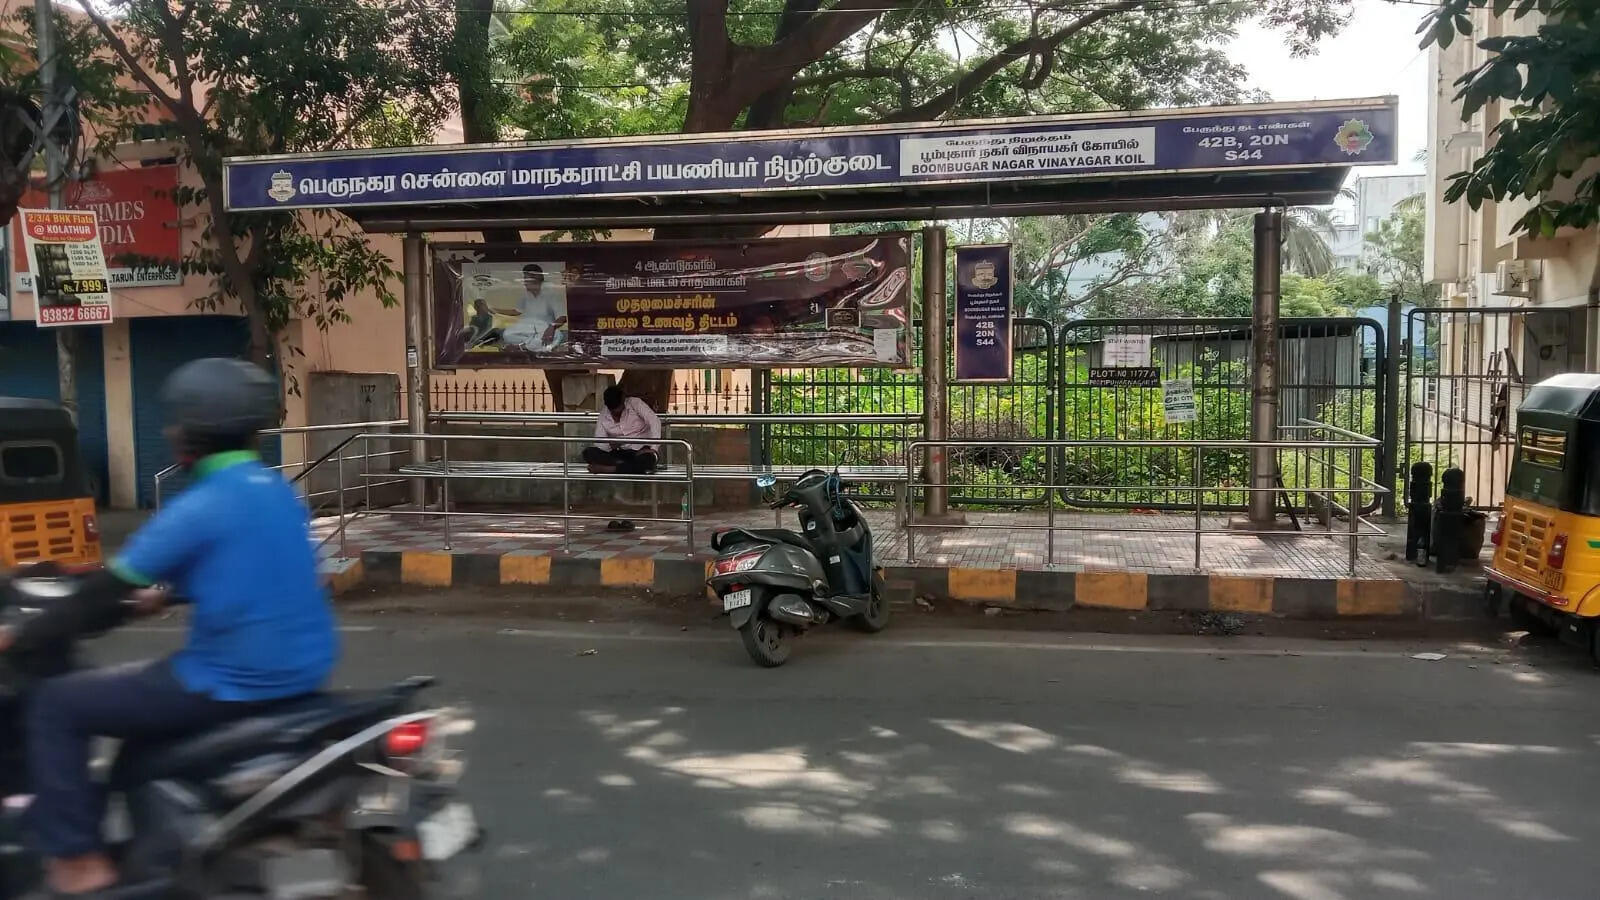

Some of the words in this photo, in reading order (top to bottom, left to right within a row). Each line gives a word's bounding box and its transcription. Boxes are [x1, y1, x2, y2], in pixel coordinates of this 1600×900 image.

[1198, 136, 1242, 148] 42B,
[1250, 134, 1289, 146] 20N
[980, 145, 1009, 160] நகர்
[1012, 142, 1078, 158] விநாயகர்
[1082, 138, 1139, 152] கோயில்
[1225, 149, 1263, 161] S44
[912, 162, 988, 174] BOOMBUGAR
[992, 159, 1034, 170] NAGAR
[1038, 156, 1110, 168] VINAYAGAR
[1114, 154, 1145, 165] KOIL
[300, 175, 396, 198] பெருநகர
[401, 168, 506, 190] சென்னை
[512, 160, 642, 190] மாநகராட்சி
[648, 156, 759, 180] பயணியர்
[764, 152, 892, 182] நிழற்குடை
[86, 200, 145, 222] TIMES
[28, 214, 50, 223] 2/3/4
[53, 214, 72, 224] BHK
[47, 225, 91, 234] KOLATHUR
[102, 224, 136, 244] DIA
[635, 261, 642, 271] 4
[136, 272, 176, 281] ENTERPRISES
[42, 308, 74, 322] 93832
[78, 306, 108, 320] 66667
[597, 317, 638, 329] காலை
[642, 314, 694, 331] உணவுத்
[699, 312, 738, 332] திட்டம்
[1091, 370, 1115, 378] PLOT
[360, 384, 376, 393] 1177
